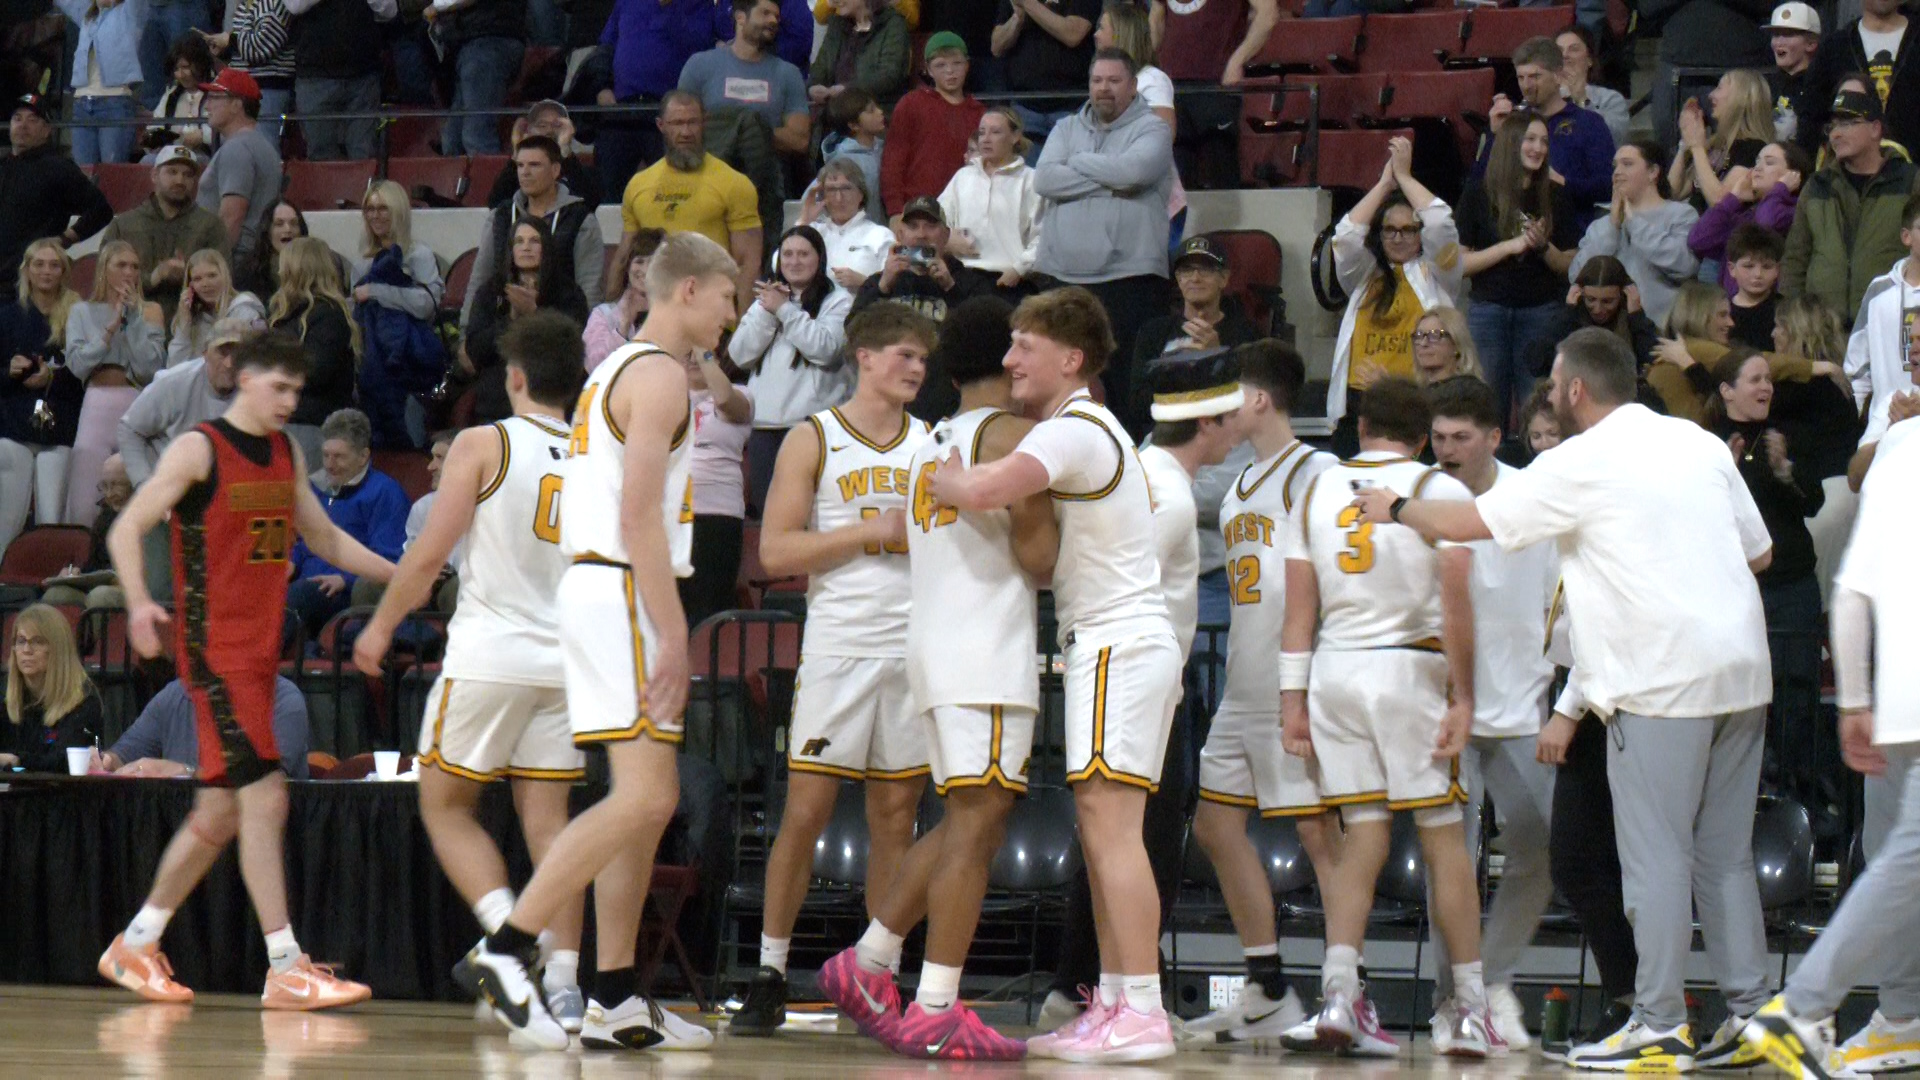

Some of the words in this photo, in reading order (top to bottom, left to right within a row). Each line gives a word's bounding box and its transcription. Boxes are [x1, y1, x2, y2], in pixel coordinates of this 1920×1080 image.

[1364, 332, 1408, 355] CASH
[533, 473, 565, 545] 0
[1335, 504, 1375, 575] 3
